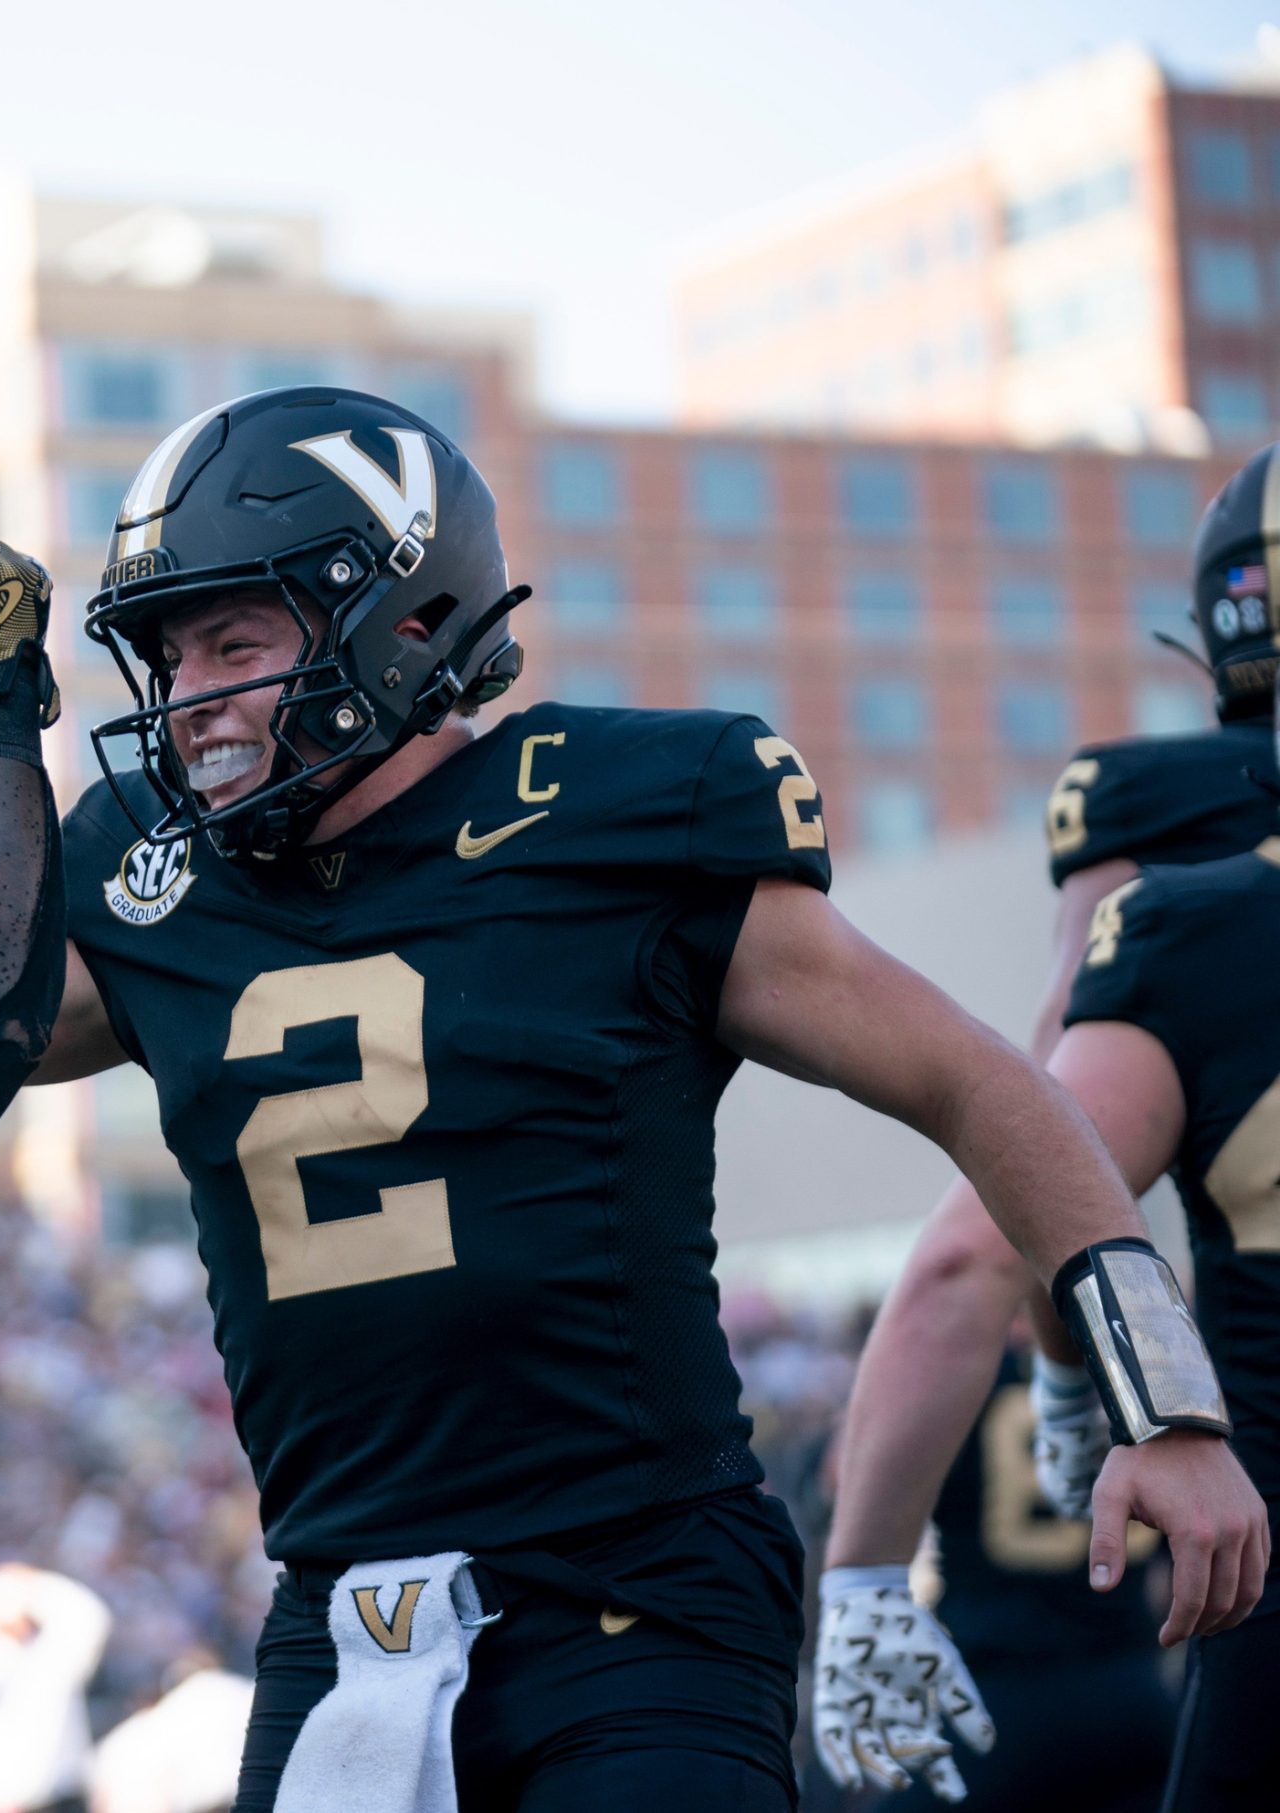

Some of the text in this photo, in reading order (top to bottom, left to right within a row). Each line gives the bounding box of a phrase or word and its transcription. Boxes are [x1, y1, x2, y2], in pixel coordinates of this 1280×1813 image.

[288, 426, 437, 540] V
[517, 732, 565, 803] C
[754, 736, 825, 849] 2
[127, 839, 186, 898] SEC
[308, 851, 346, 890] V
[111, 889, 179, 922] GRADUATE
[222, 952, 457, 1301] 2
[350, 1578, 430, 1653] V
